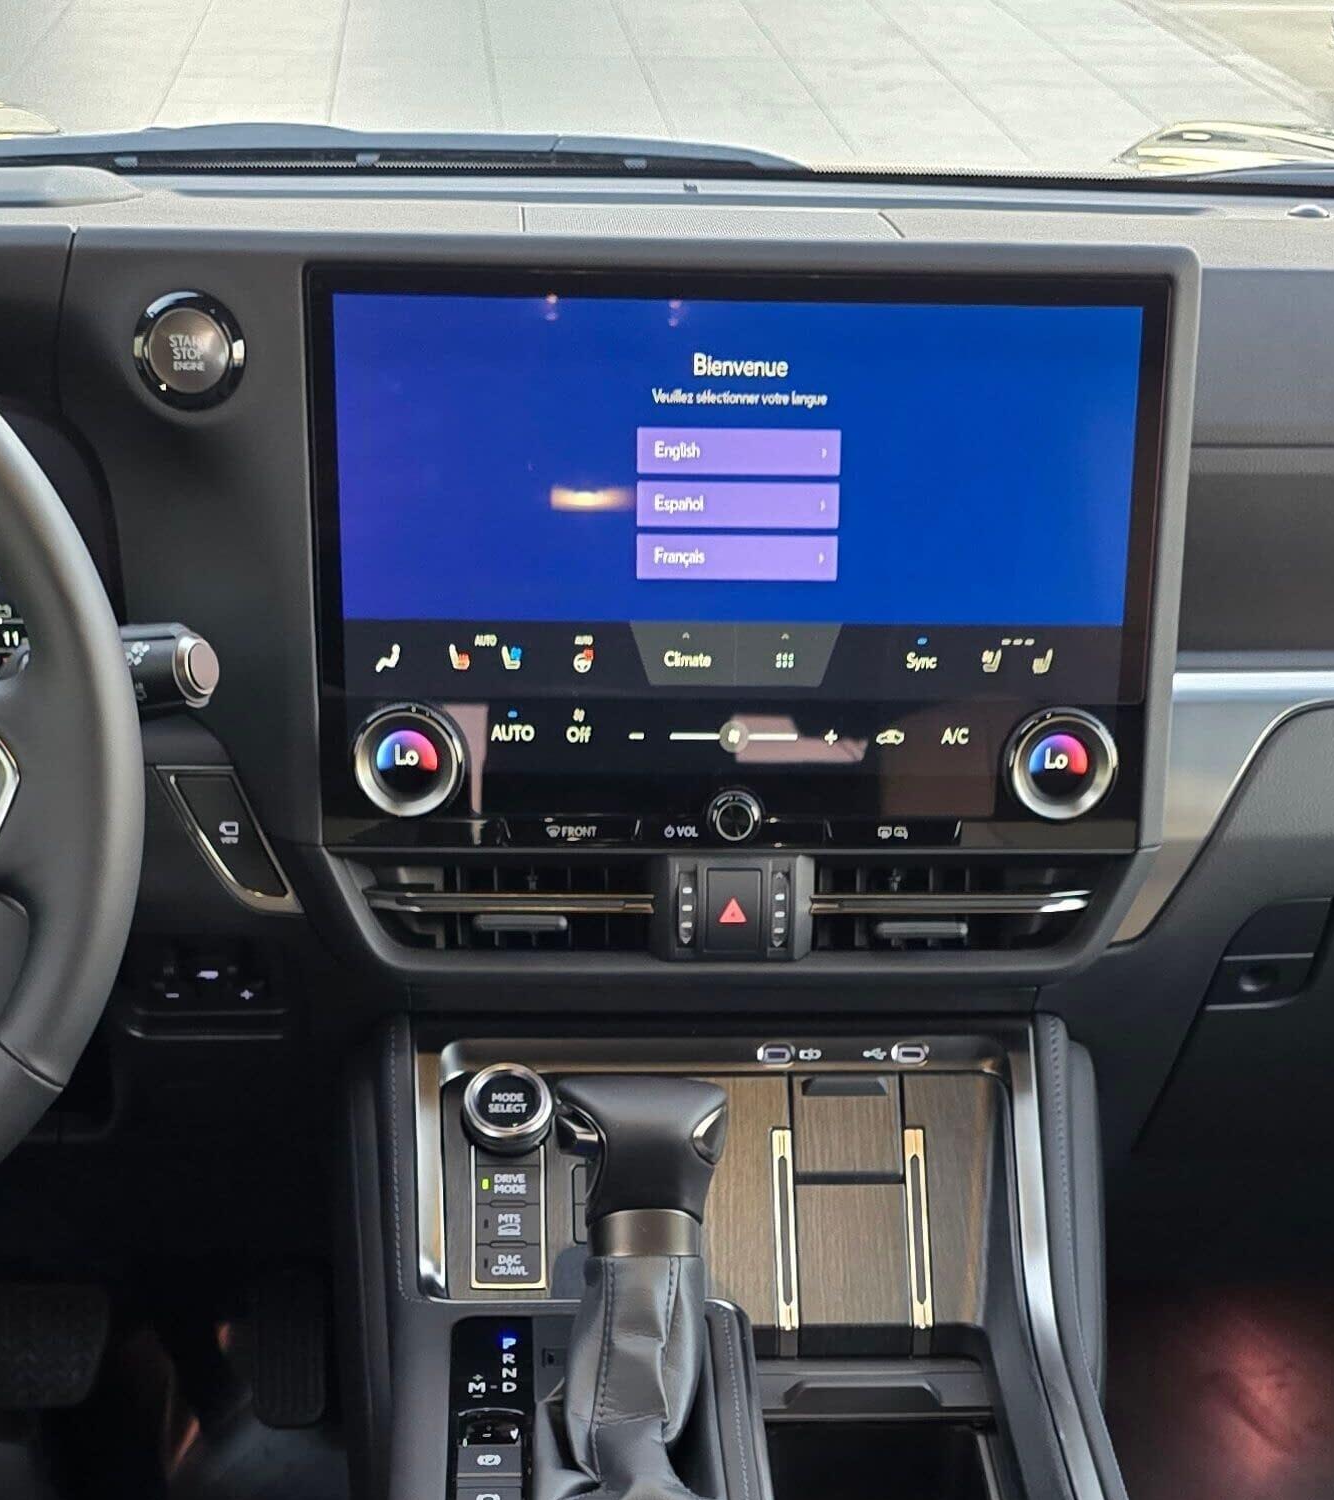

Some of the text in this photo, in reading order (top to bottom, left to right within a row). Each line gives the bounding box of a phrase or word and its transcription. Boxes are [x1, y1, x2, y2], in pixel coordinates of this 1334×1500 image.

[172, 349, 204, 360] STOP
[172, 362, 205, 372] ENGINE
[693, 352, 789, 377] Bienvenue
[651, 387, 828, 409] Veuillez sélectionner votre langue
[654, 440, 701, 461] English
[654, 494, 704, 514] Español
[653, 546, 706, 568] Français
[474, 634, 498, 647] AUTO
[663, 650, 712, 669] Climate
[906, 652, 937, 672] Sync
[490, 724, 536, 743] AUTO
[566, 726, 592, 743] Off
[941, 727, 970, 746] A/C
[394, 744, 419, 767] Lo
[1044, 747, 1068, 771] Lo
[561, 825, 597, 839] FRONT
[676, 826, 699, 838] VOL
[491, 1093, 525, 1103] MODE
[487, 1103, 528, 1114] SELECT
[494, 1174, 526, 1184] DRIVE
[494, 1184, 527, 1195] MODE
[498, 1213, 521, 1224] MTS
[498, 1254, 521, 1265] DAC
[491, 1265, 529, 1276] CRAWL
[502, 1337, 517, 1350] P
[502, 1353, 516, 1364] R
[501, 1367, 517, 1379] N
[468, 1382, 486, 1394] M
[502, 1381, 517, 1393] D
